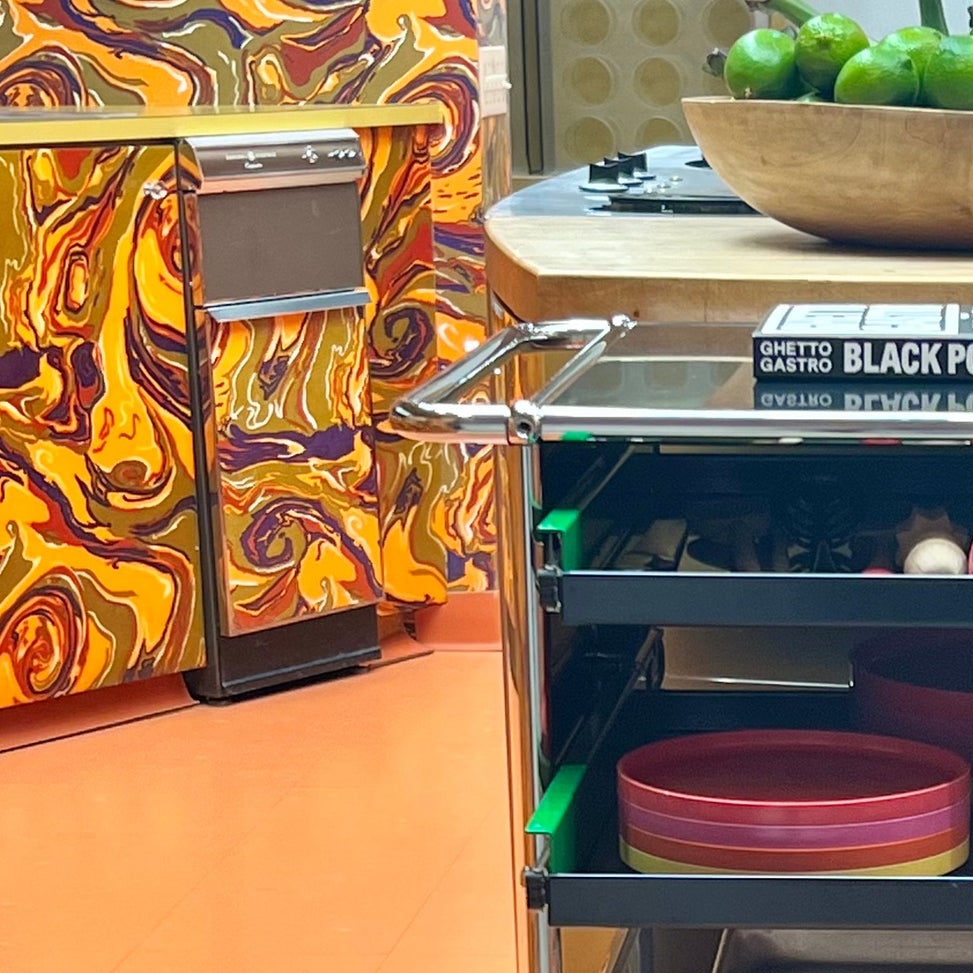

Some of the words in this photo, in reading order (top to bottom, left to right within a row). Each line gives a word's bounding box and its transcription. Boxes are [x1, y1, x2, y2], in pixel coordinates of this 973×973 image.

[760, 341, 833, 357] GHETTO
[760, 357, 833, 374] GASTRO
[843, 342, 942, 375] BLACK
